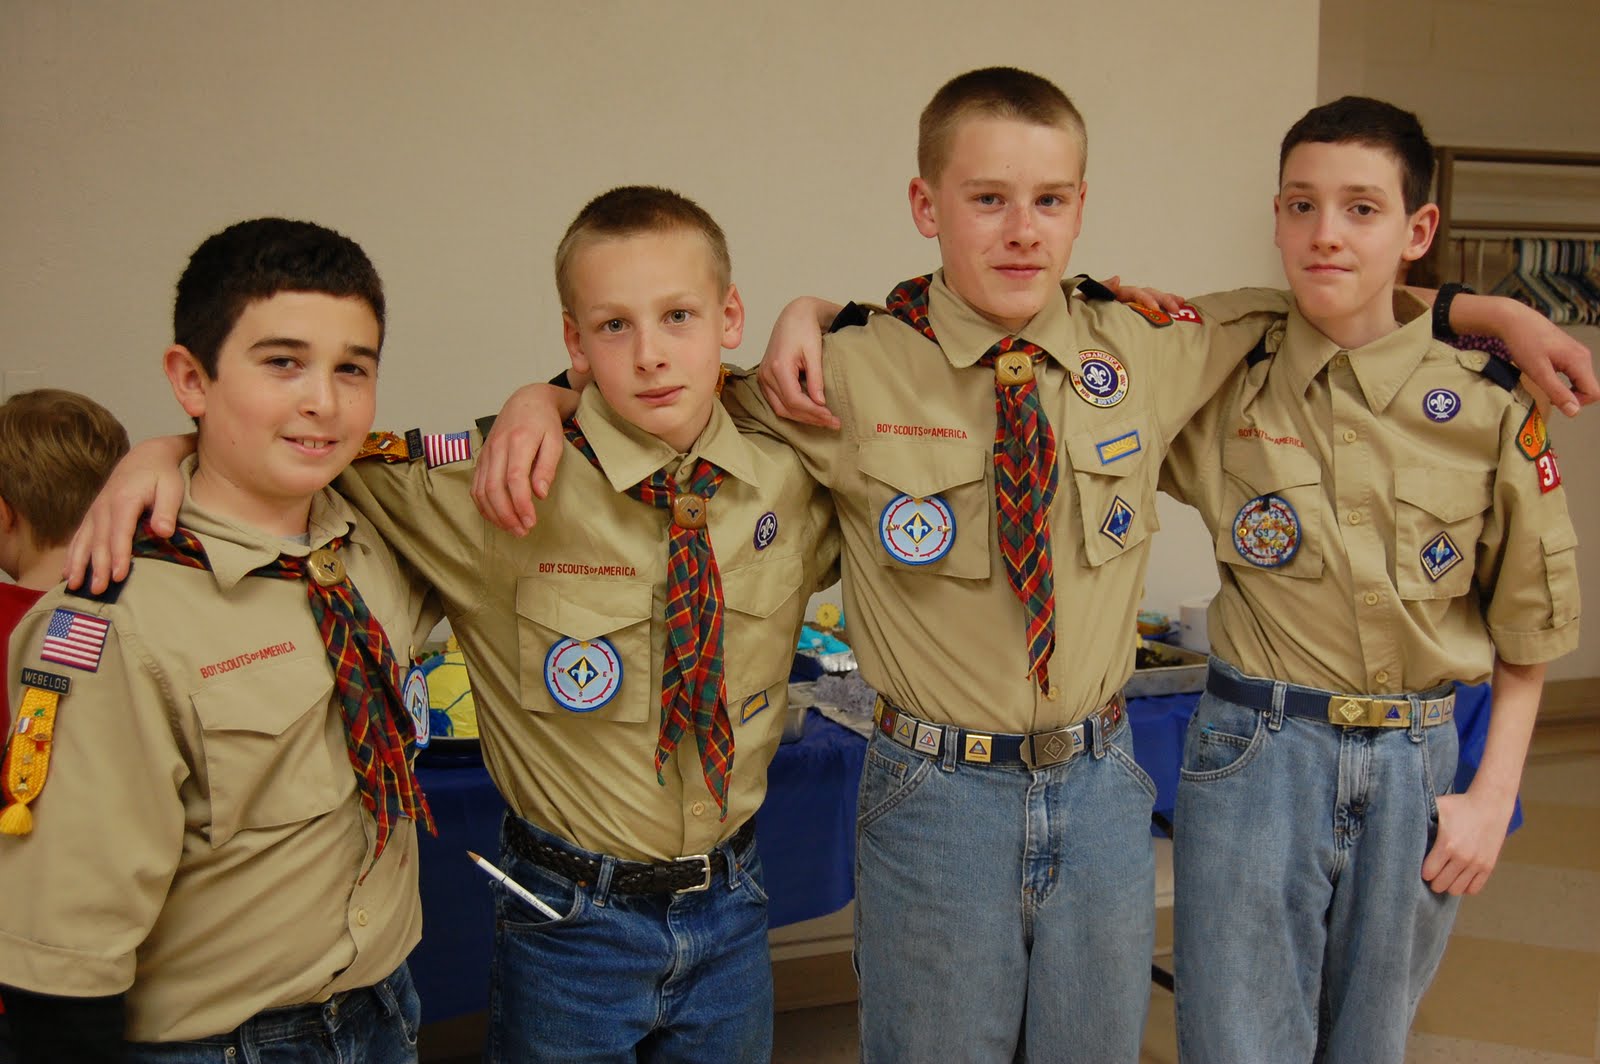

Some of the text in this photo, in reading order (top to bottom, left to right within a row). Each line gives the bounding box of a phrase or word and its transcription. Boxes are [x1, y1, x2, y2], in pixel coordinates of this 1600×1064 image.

[876, 423, 892, 433] BOY
[893, 424, 923, 437] SCOUTS
[931, 427, 968, 440] AMERICA
[1238, 428, 1252, 438] BOY
[1273, 436, 1305, 449] AMERICA
[539, 562, 556, 573] BOY
[557, 563, 590, 575] SCOUTS
[597, 566, 636, 577] AMERICA
[200, 641, 296, 679] BOY SCOUTS OF AMERICA
[25, 671, 68, 691] WEBELOS
